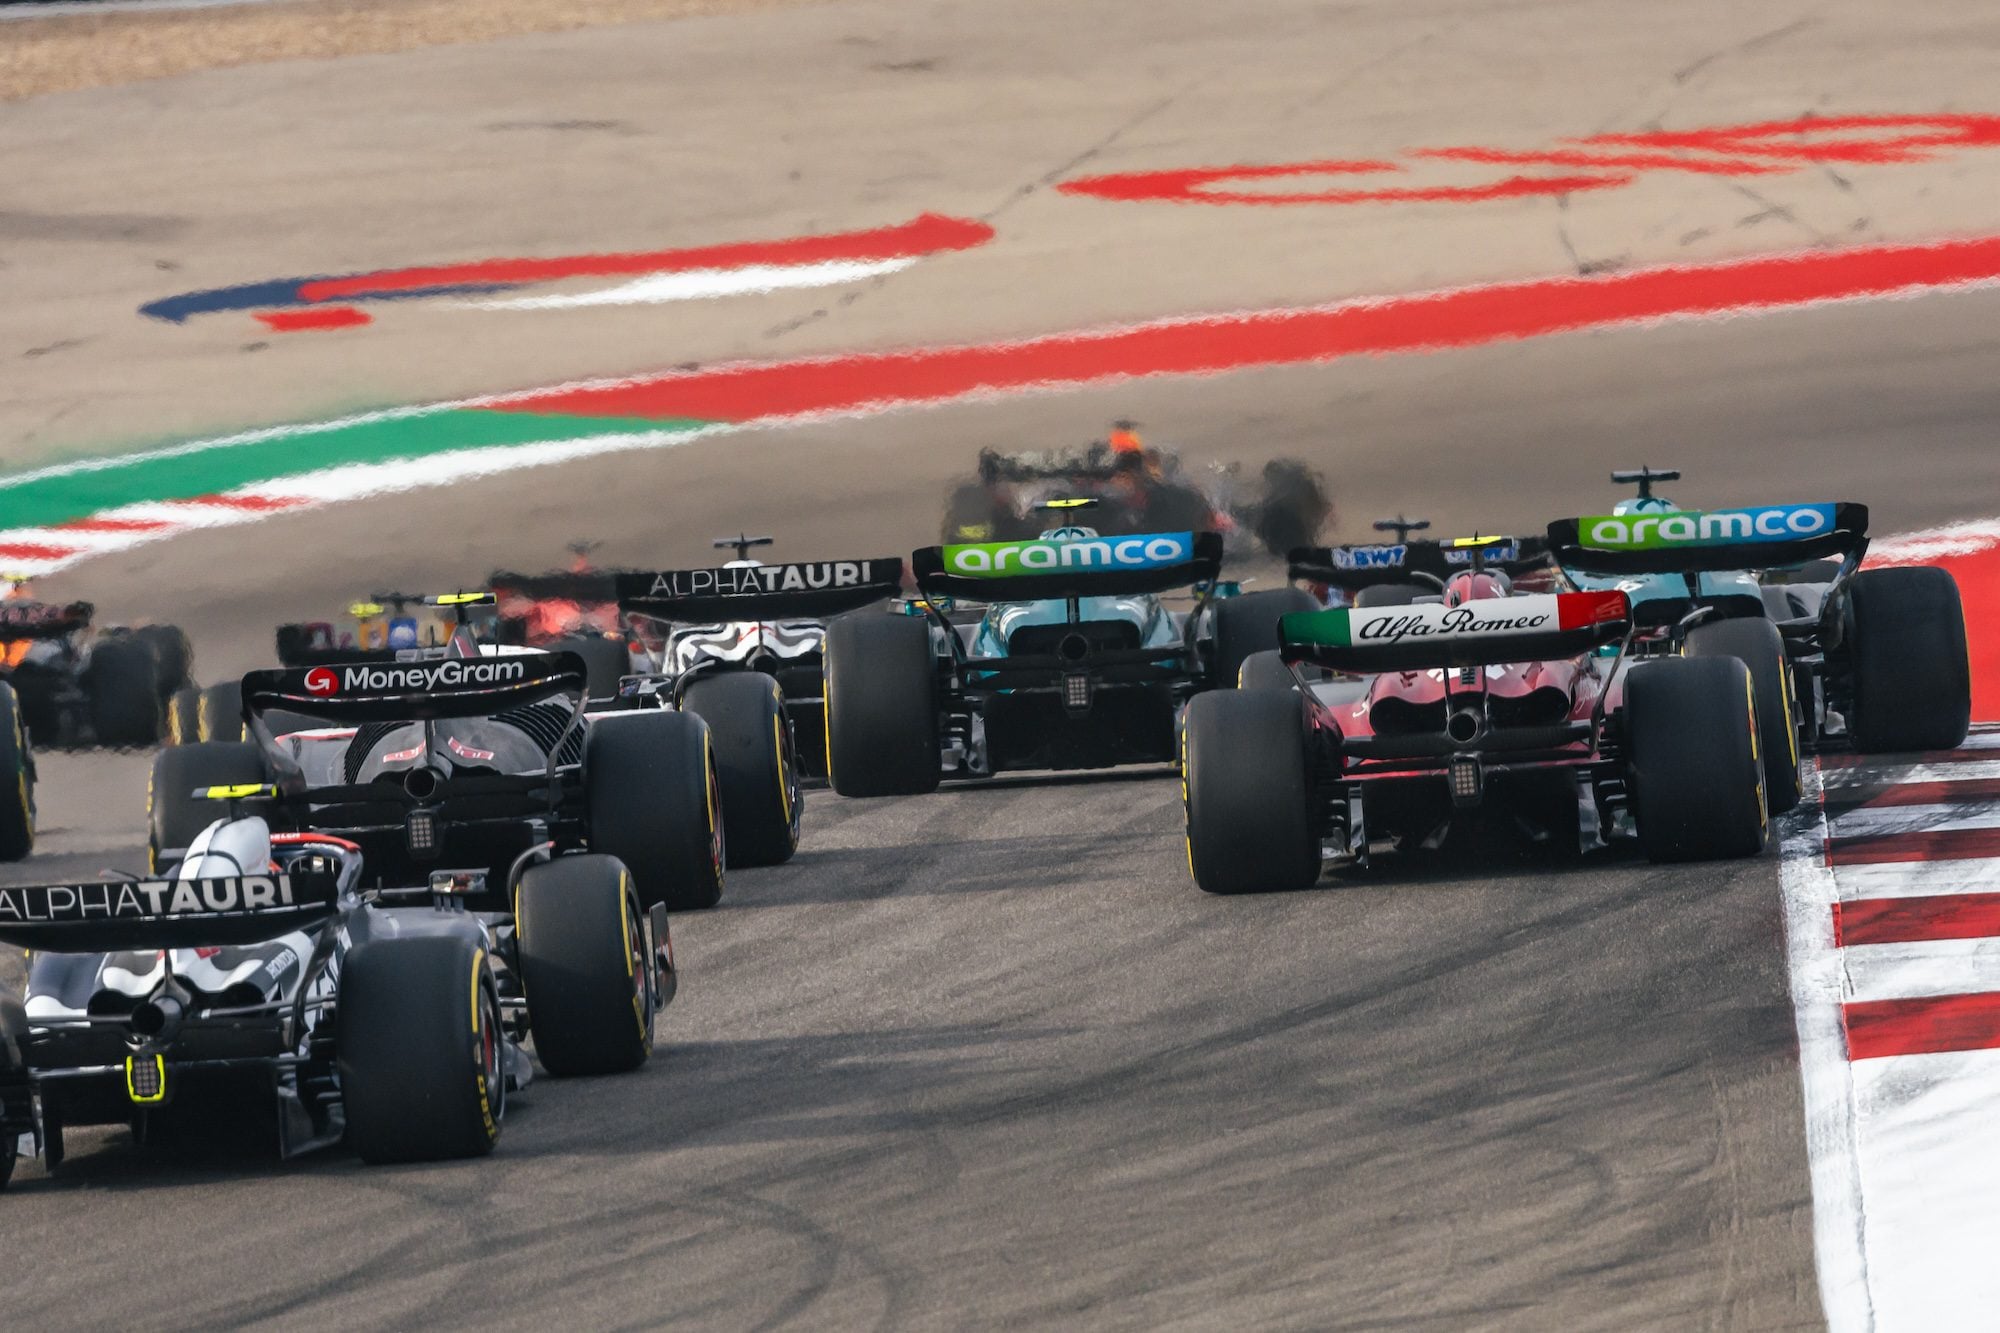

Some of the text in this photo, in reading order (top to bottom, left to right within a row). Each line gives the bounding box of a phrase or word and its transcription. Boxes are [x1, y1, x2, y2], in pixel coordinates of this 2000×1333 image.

[1591, 508, 1825, 544] aramco
[954, 538, 1182, 571] aramco
[650, 562, 871, 597] ALPHATAURI
[1359, 609, 1549, 643] Alfa Romeo
[344, 661, 524, 690] MoneyGram
[0, 875, 293, 920] ALPHATAURI
[265, 948, 297, 979] HONDA
